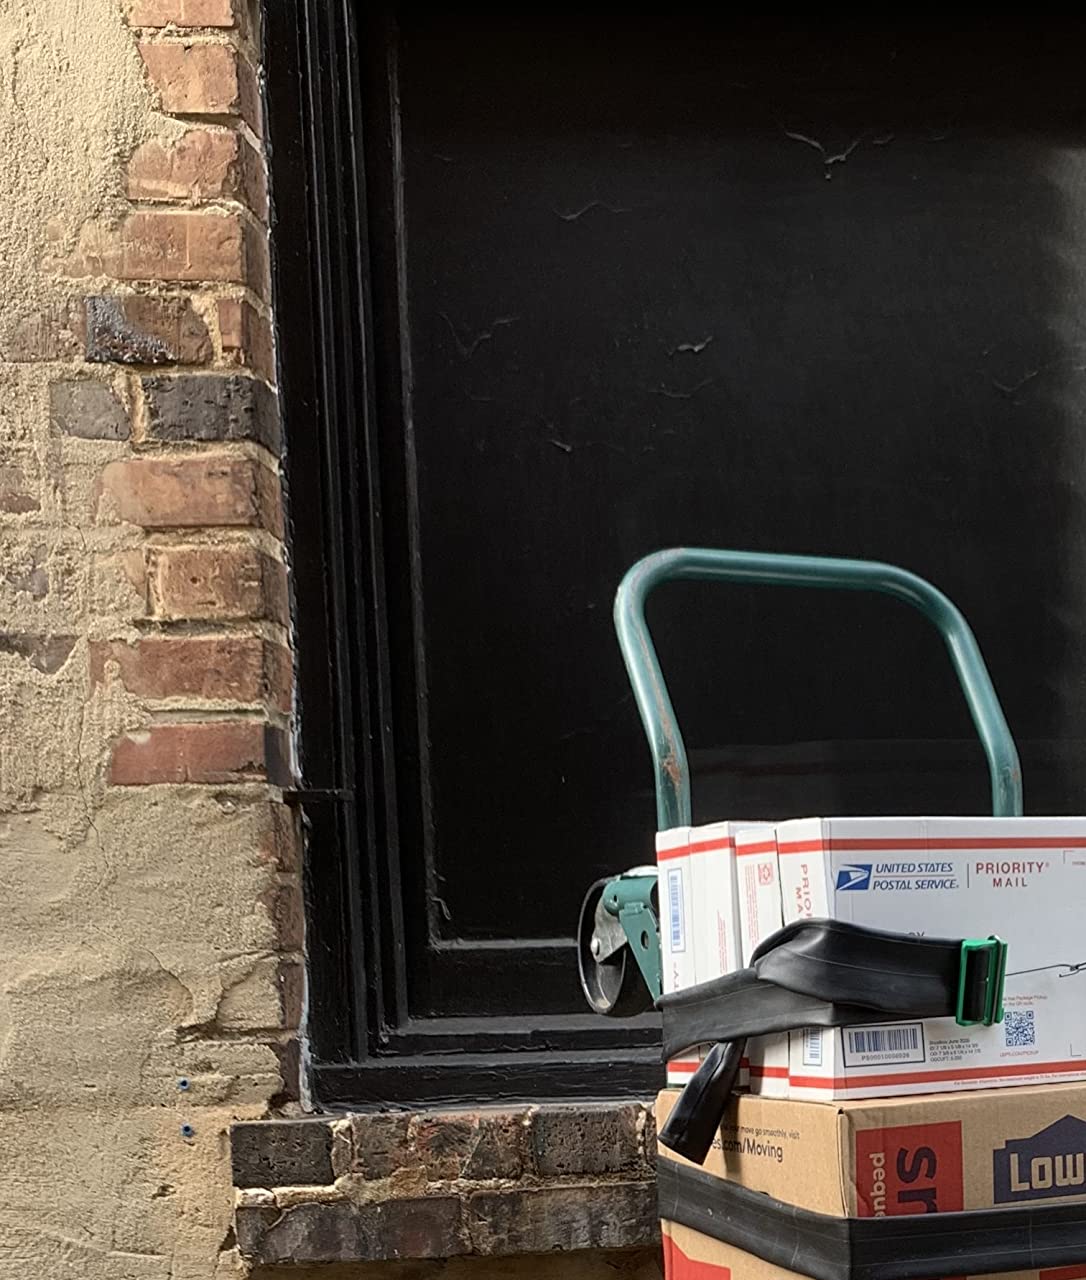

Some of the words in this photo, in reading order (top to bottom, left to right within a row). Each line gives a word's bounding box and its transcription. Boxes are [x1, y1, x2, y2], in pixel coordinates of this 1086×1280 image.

[875, 863, 916, 874] UNITED
[918, 862, 953, 873] STATES
[873, 880, 913, 891] POSTAL
[992, 878, 1028, 888] MAIL
[741, 1126, 755, 1134] move
[755, 1128, 762, 1136] go
[712, 1137, 783, 1163] es.com/Moving
